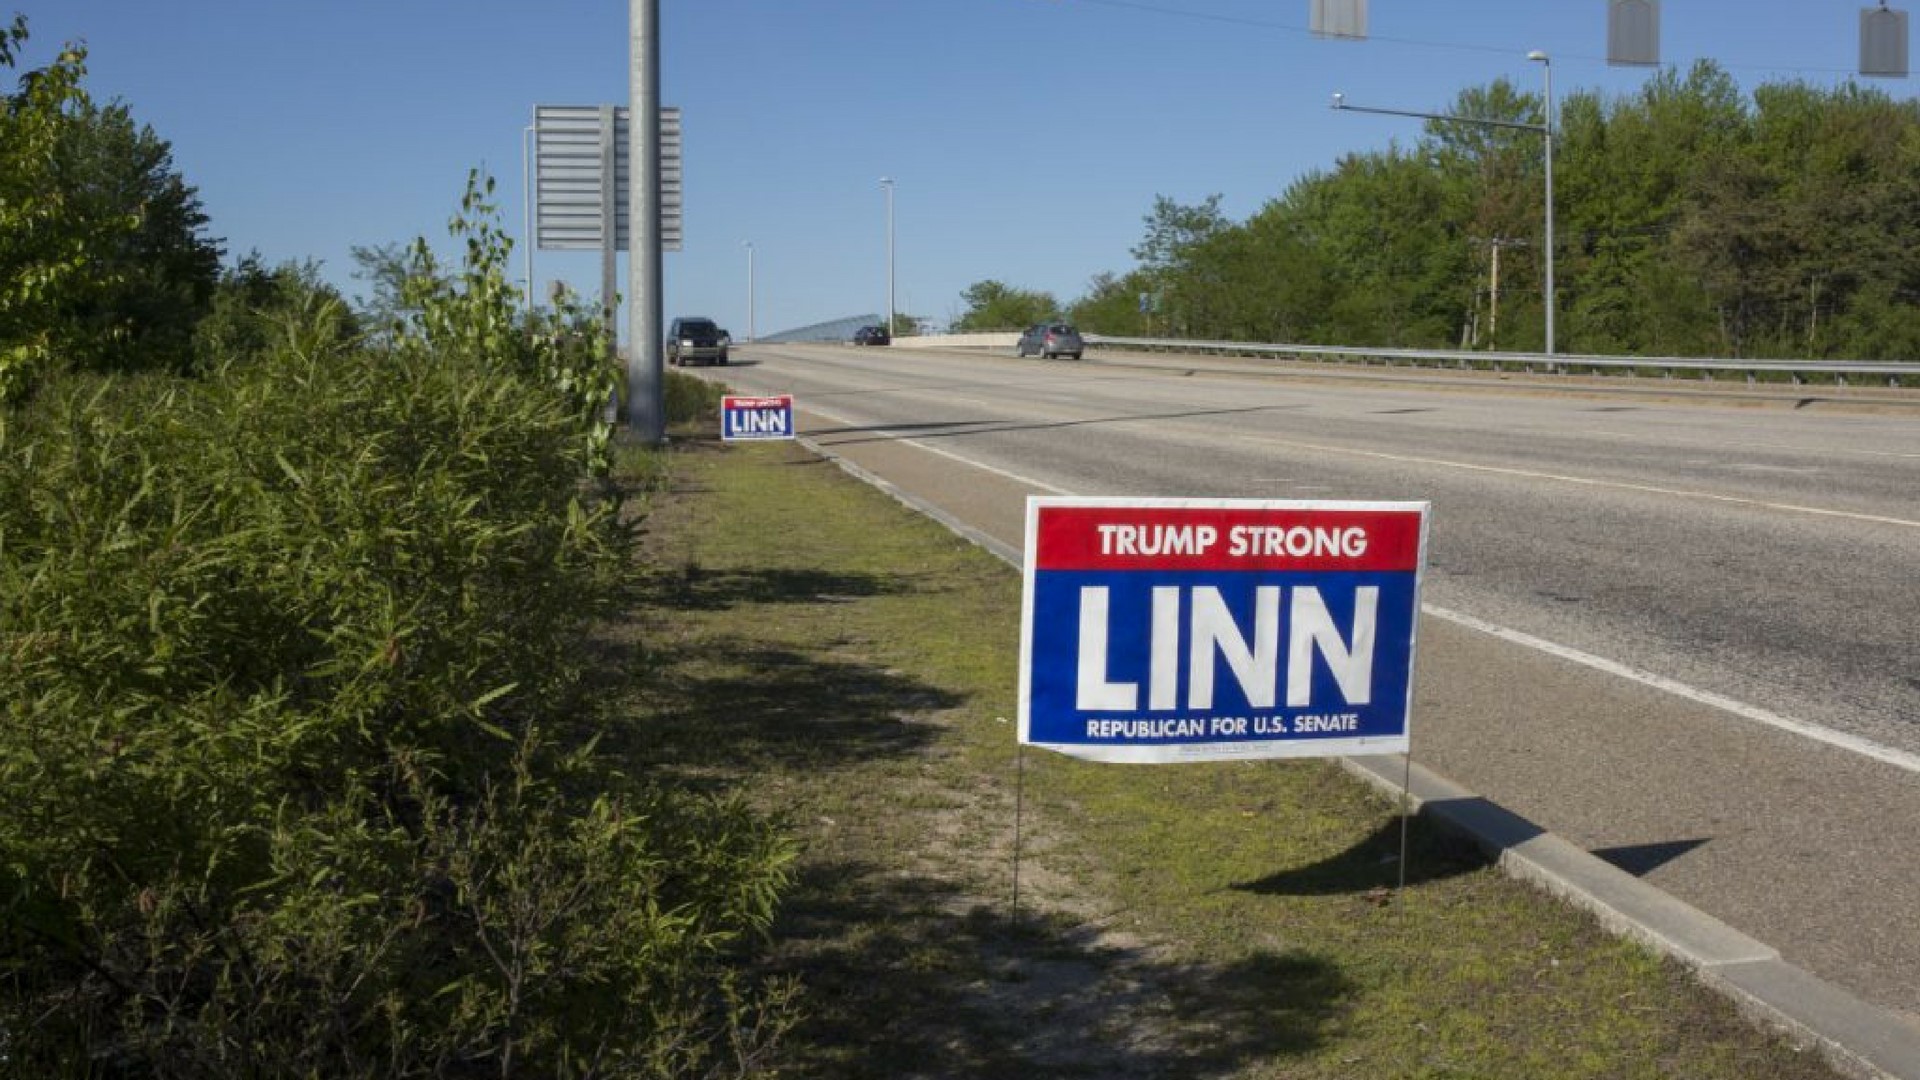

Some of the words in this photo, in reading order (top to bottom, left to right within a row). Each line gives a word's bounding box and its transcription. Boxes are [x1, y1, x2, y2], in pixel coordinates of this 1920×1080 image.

[731, 410, 786, 432] LINN
[1097, 524, 1217, 555] TRUMP
[1229, 525, 1368, 557] STRONG
[1076, 585, 1379, 711] LINN
[1086, 718, 1204, 738] REPUBLICAN
[1210, 717, 1247, 736] FOR
[1253, 715, 1288, 734] U.S.
[1293, 713, 1357, 733] SENATE
